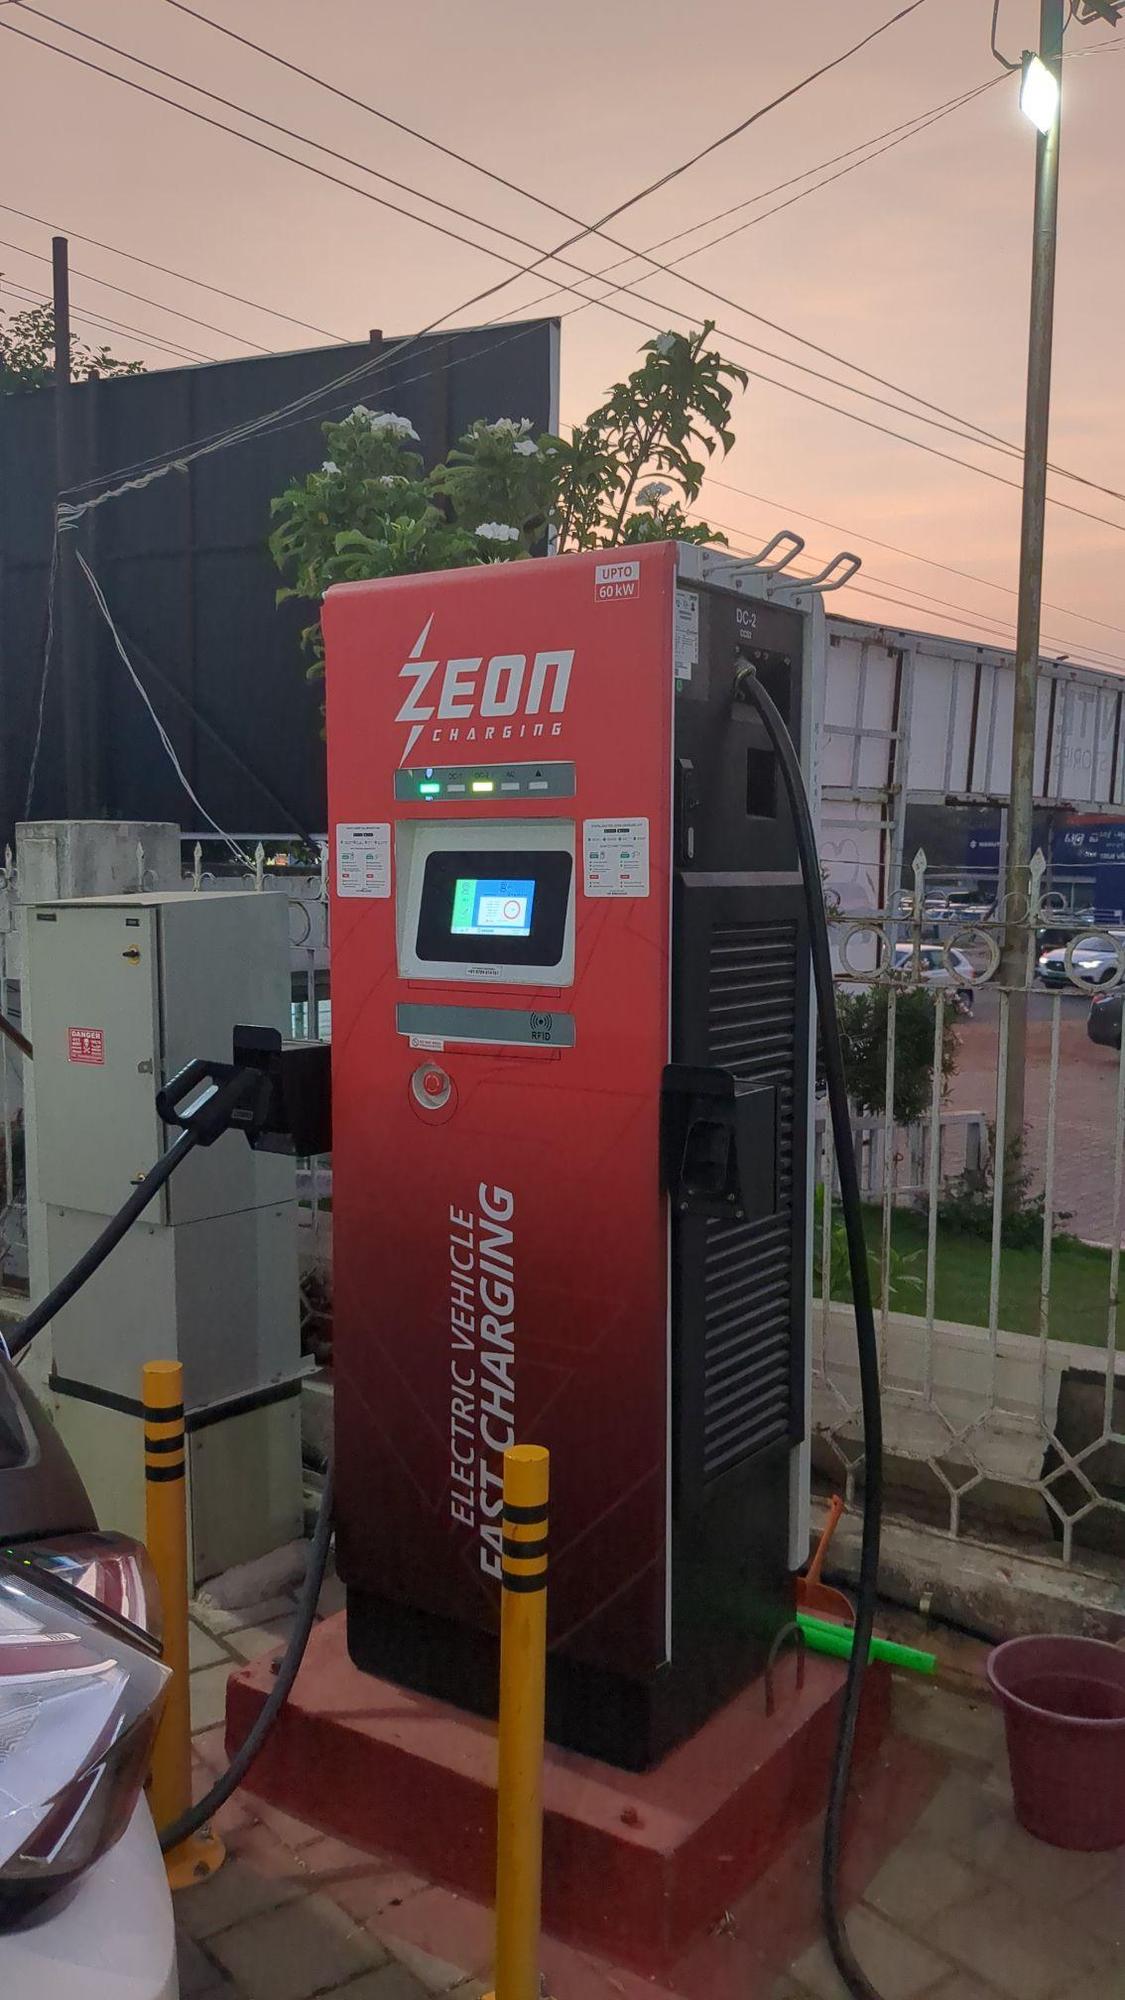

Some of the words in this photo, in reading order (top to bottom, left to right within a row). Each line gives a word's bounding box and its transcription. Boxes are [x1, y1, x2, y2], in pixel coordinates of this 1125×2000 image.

[602, 567, 633, 580] UPTO
[599, 586, 614, 599] 60
[615, 584, 635, 598] kW
[736, 608, 757, 628] DC-2
[395, 649, 576, 722] ZEON
[432, 722, 563, 742] CHARGING
[71, 1030, 102, 1039] DANGER
[531, 1031, 551, 1041] RFID
[450, 1204, 475, 1351] VEHICLE
[478, 1181, 515, 1453] CHARGING
[450, 1359, 475, 1529] ELECTRIC
[479, 1468, 504, 1580] FAST
